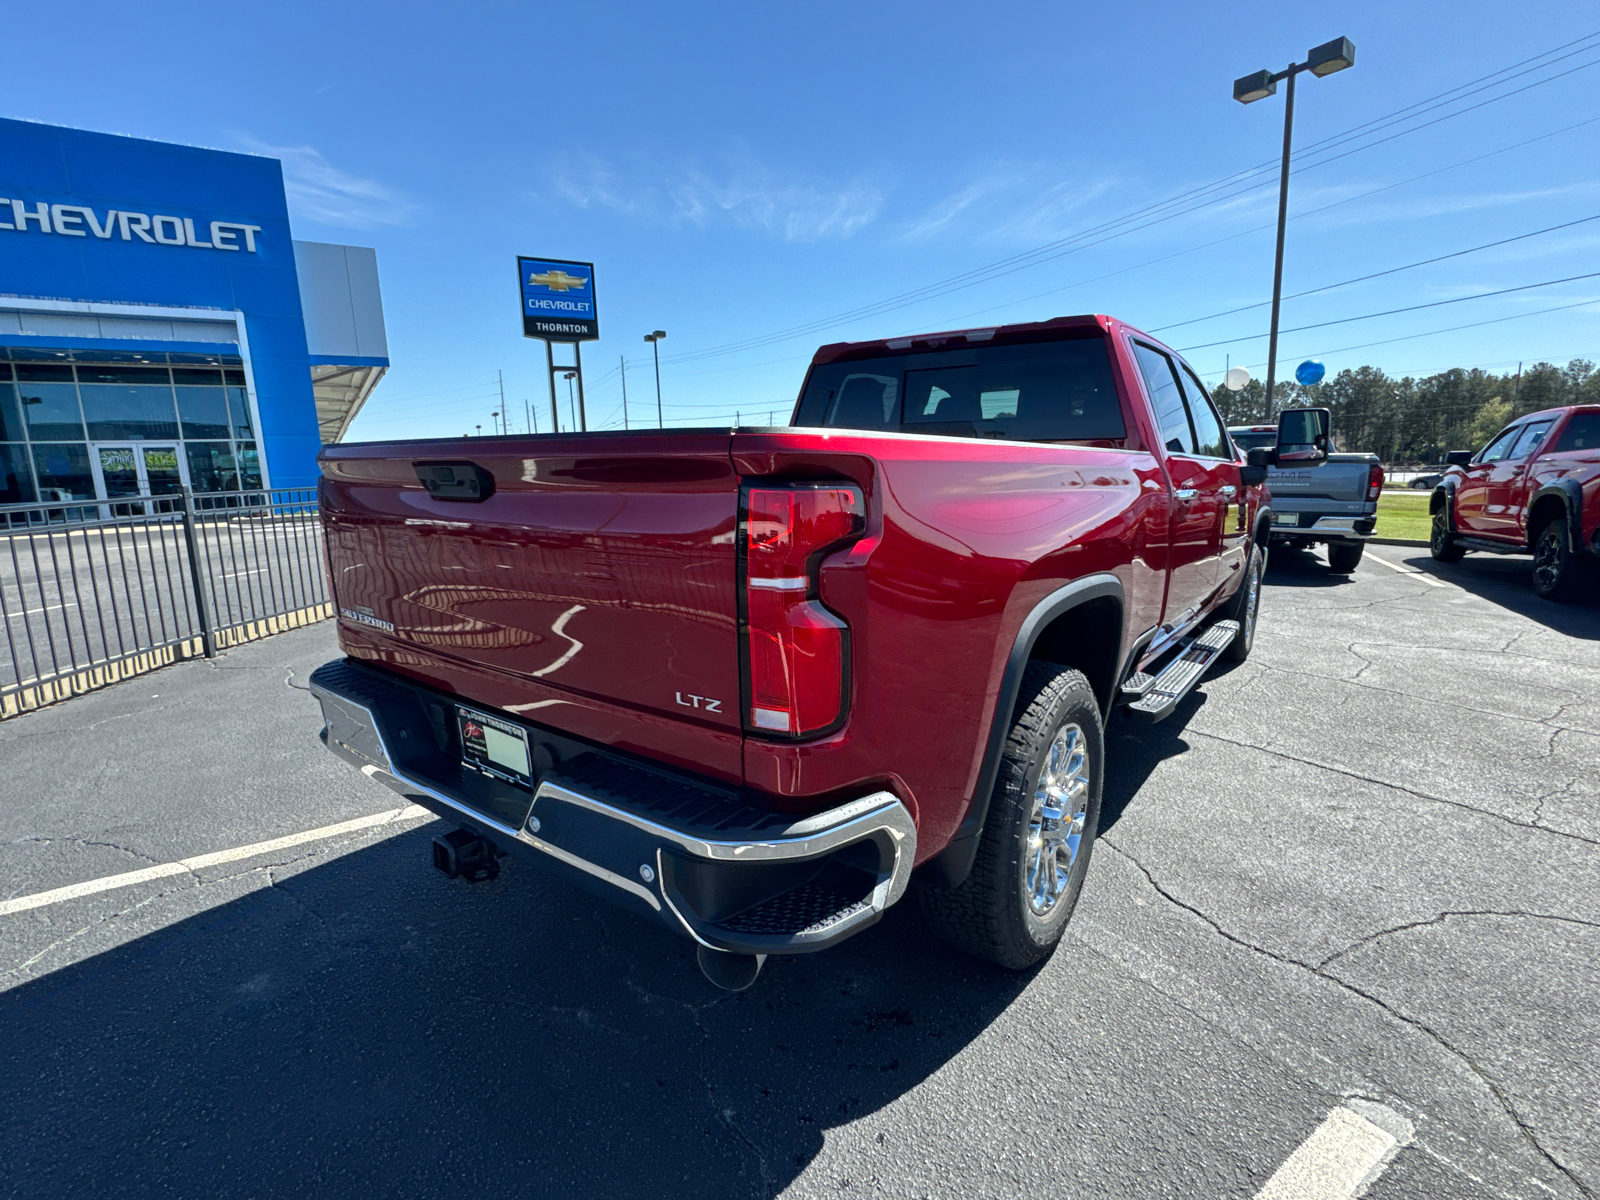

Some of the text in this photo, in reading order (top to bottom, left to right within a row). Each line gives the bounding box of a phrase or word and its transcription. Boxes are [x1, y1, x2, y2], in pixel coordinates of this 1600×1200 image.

[528, 298, 590, 312] CHEVROLET
[536, 322, 588, 333] THORNTON
[1267, 471, 1312, 479] GMC
[341, 607, 395, 632] SILVERADO
[675, 691, 722, 713] LTZ
[470, 711, 488, 725] JOHN
[486, 717, 523, 738] THORNTON
